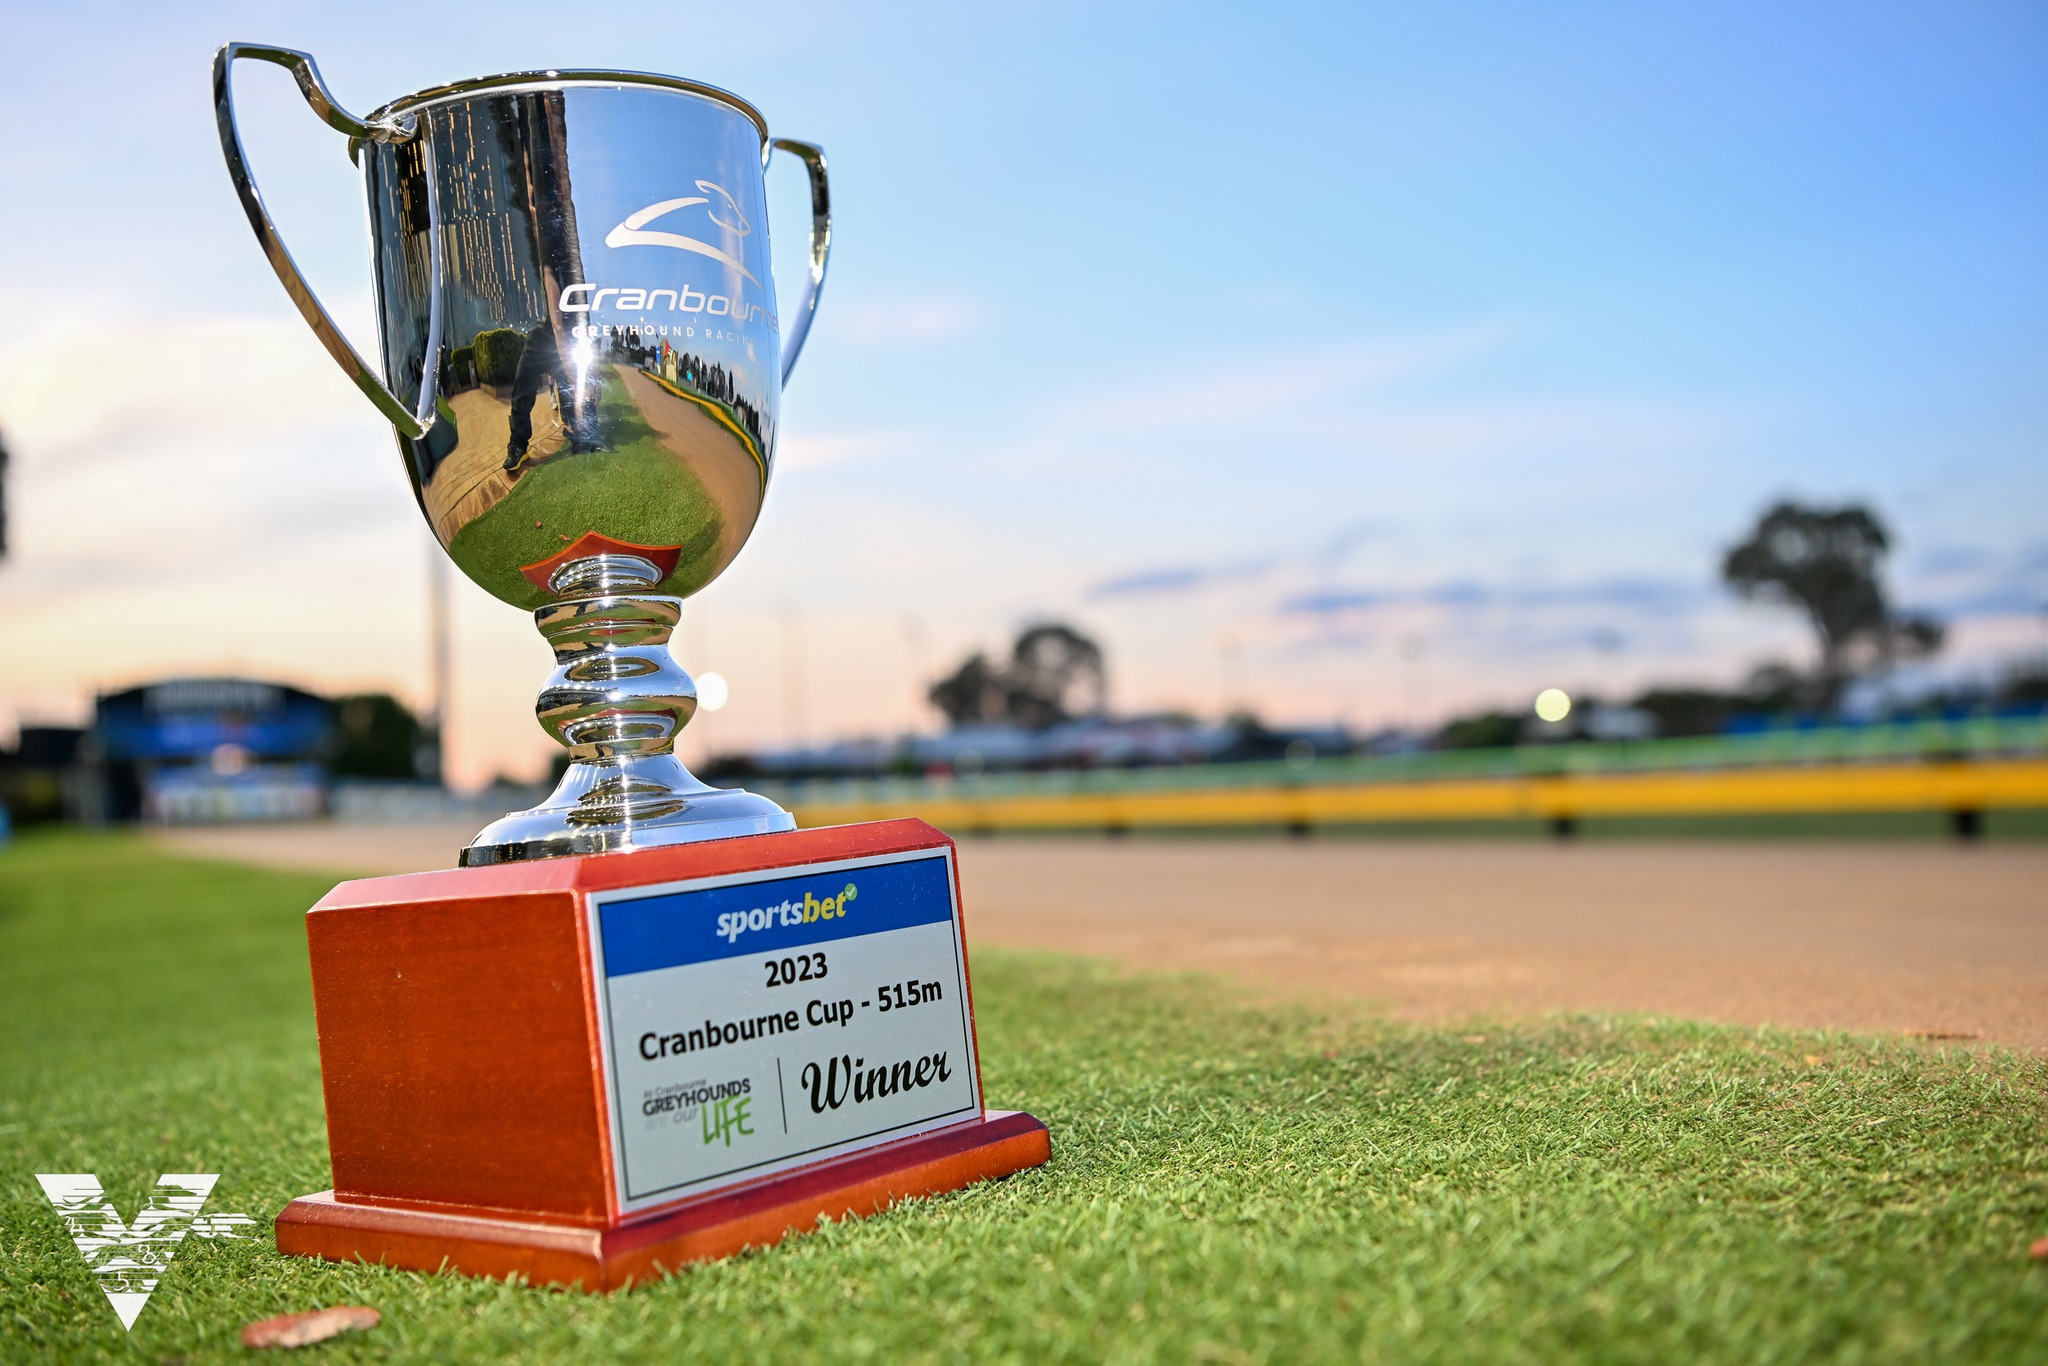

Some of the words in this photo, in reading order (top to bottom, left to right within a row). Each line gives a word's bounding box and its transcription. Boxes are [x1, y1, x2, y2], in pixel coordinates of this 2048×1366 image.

[559, 283, 778, 335] Cranbourne
[572, 323, 695, 339] GREYHOUND
[705, 328, 757, 347] RACING
[715, 891, 847, 943] sportsbet
[765, 952, 828, 988] 2023
[639, 1009, 799, 1061] Cranbourne
[806, 998, 854, 1028] Cup
[878, 979, 943, 1013] 515m
[642, 1078, 751, 1116] GREYHOUNDS
[801, 1051, 952, 1114] Winner
[702, 1095, 754, 1148] LIFE
